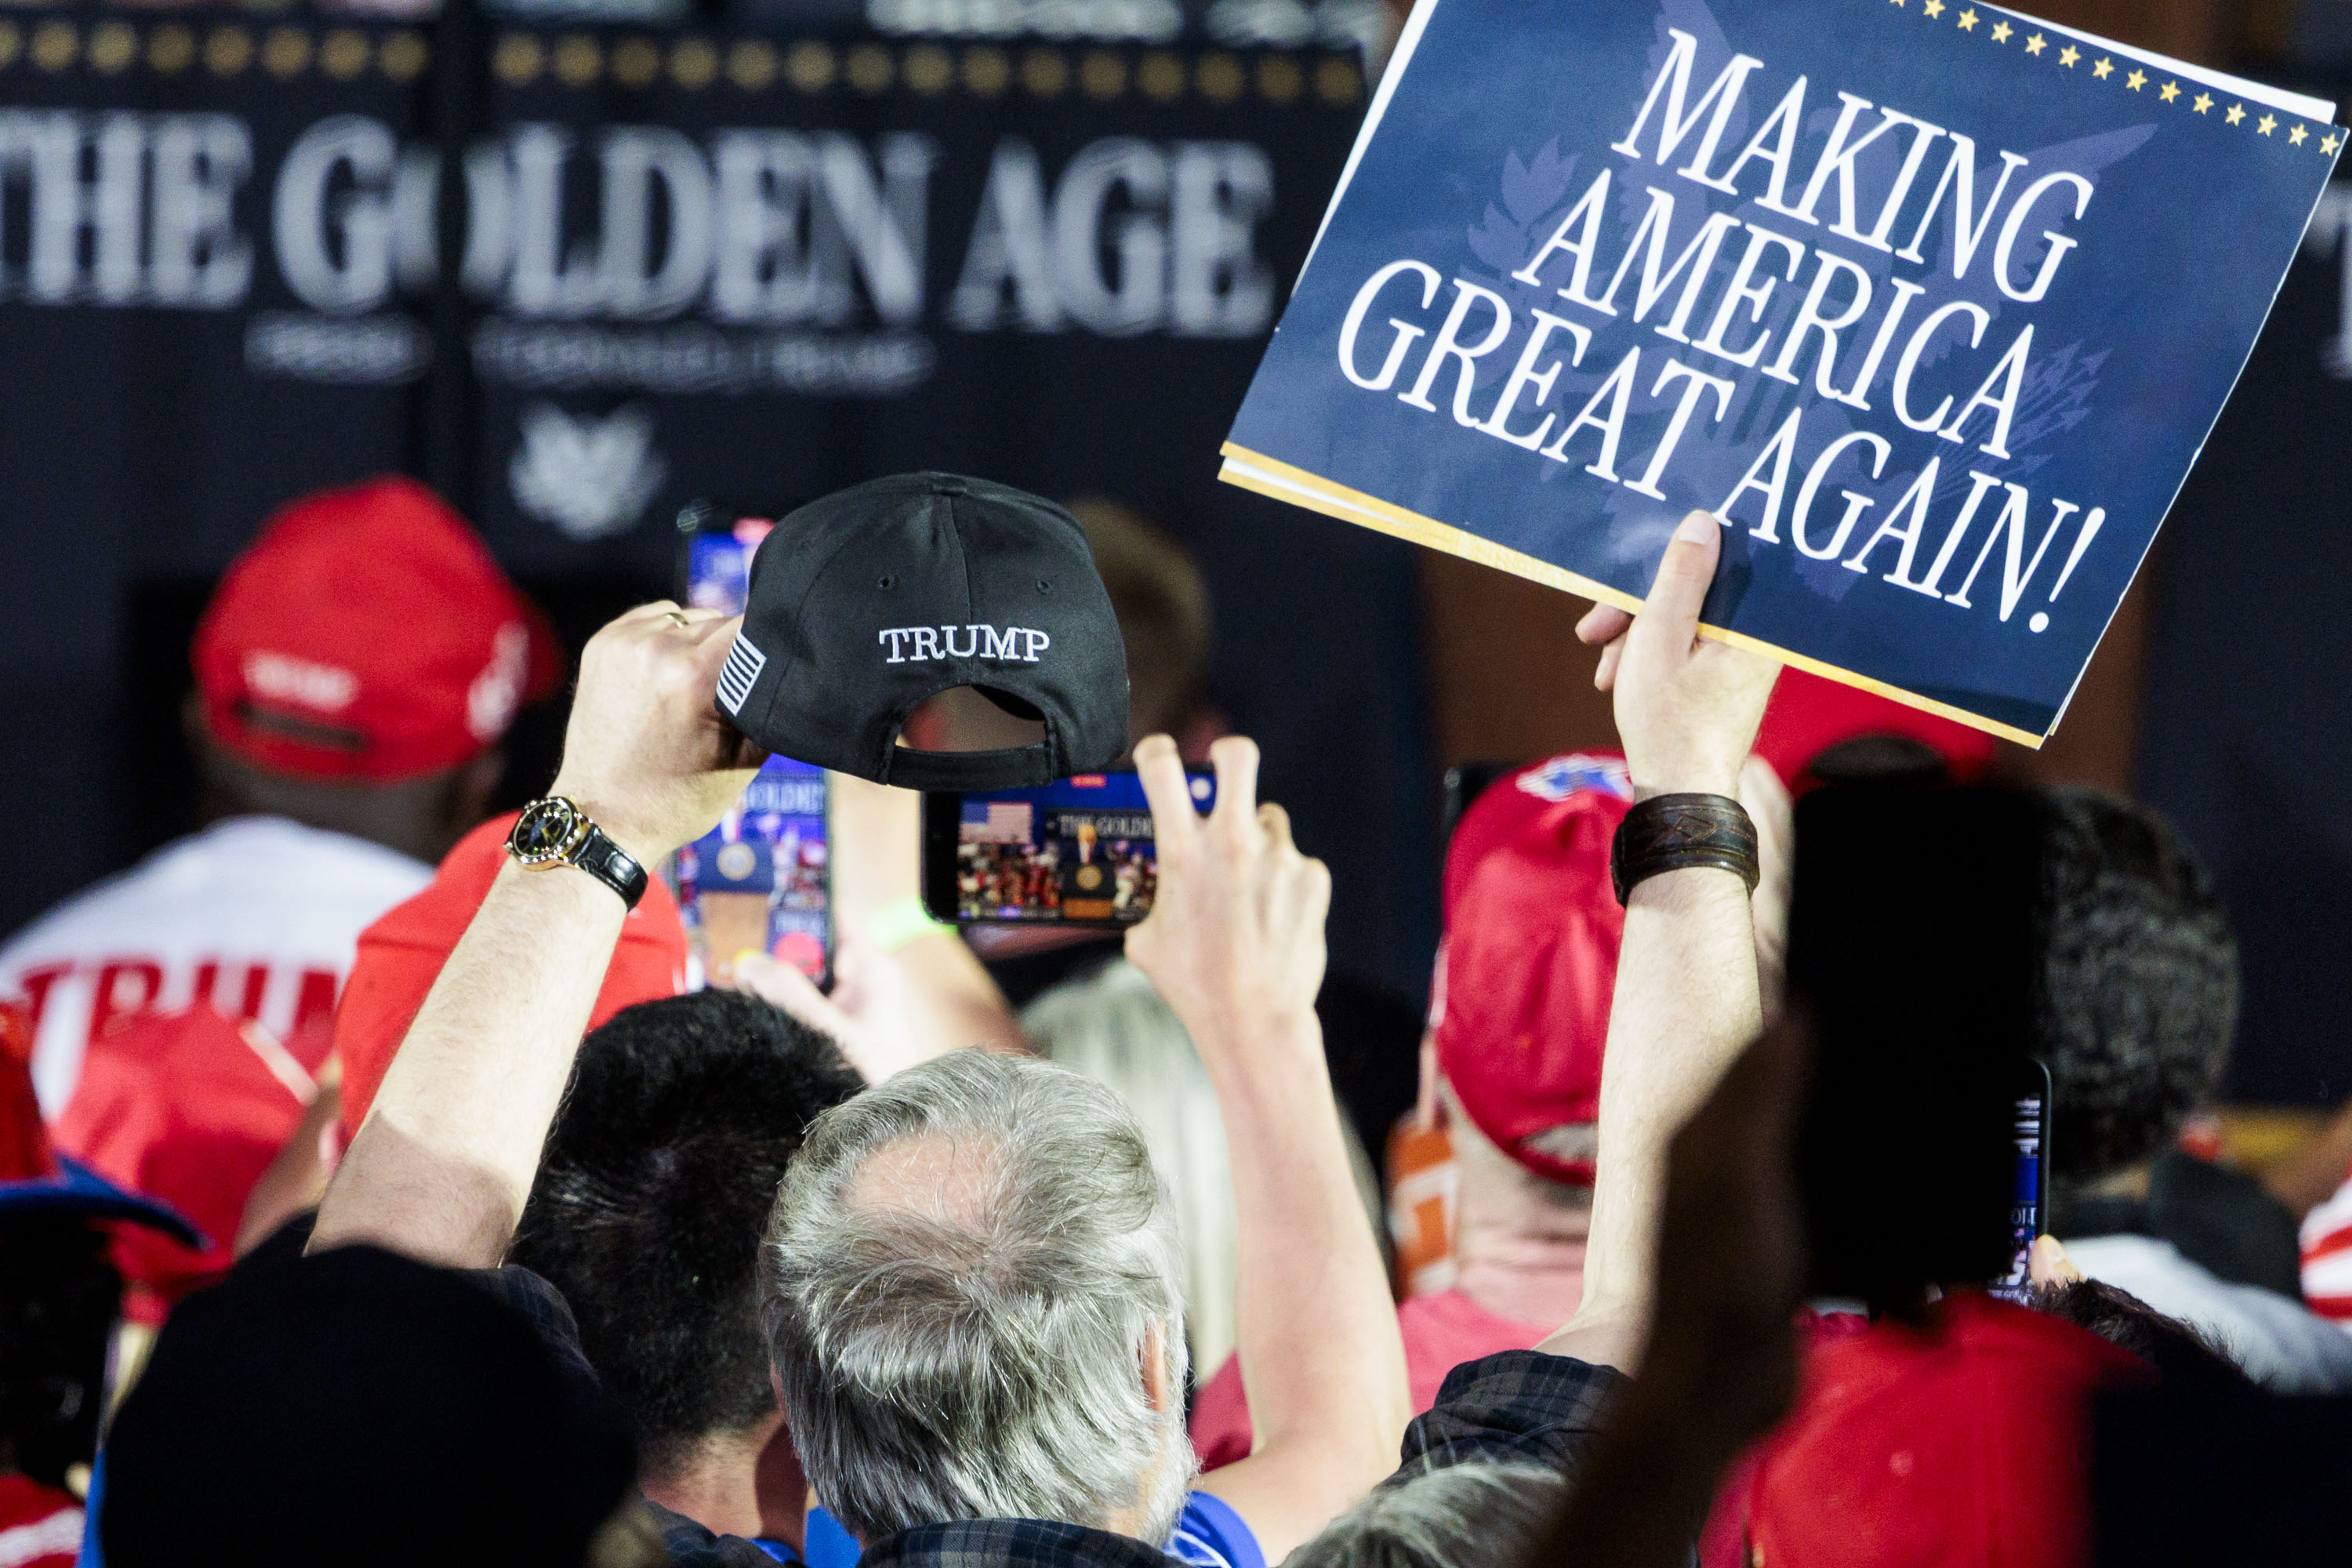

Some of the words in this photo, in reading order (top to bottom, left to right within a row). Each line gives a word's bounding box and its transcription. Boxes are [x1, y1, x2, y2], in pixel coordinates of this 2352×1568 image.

[272, 114, 933, 325] GOLDEN
[949, 136, 1276, 337] AGE
[1611, 27, 2094, 303] MAKING
[1338, 259, 1736, 502] GREAT
[1711, 406, 2106, 633] AGAIN!
[1512, 168, 2034, 460] AMERICA
[879, 624, 1050, 662] TRUMP
